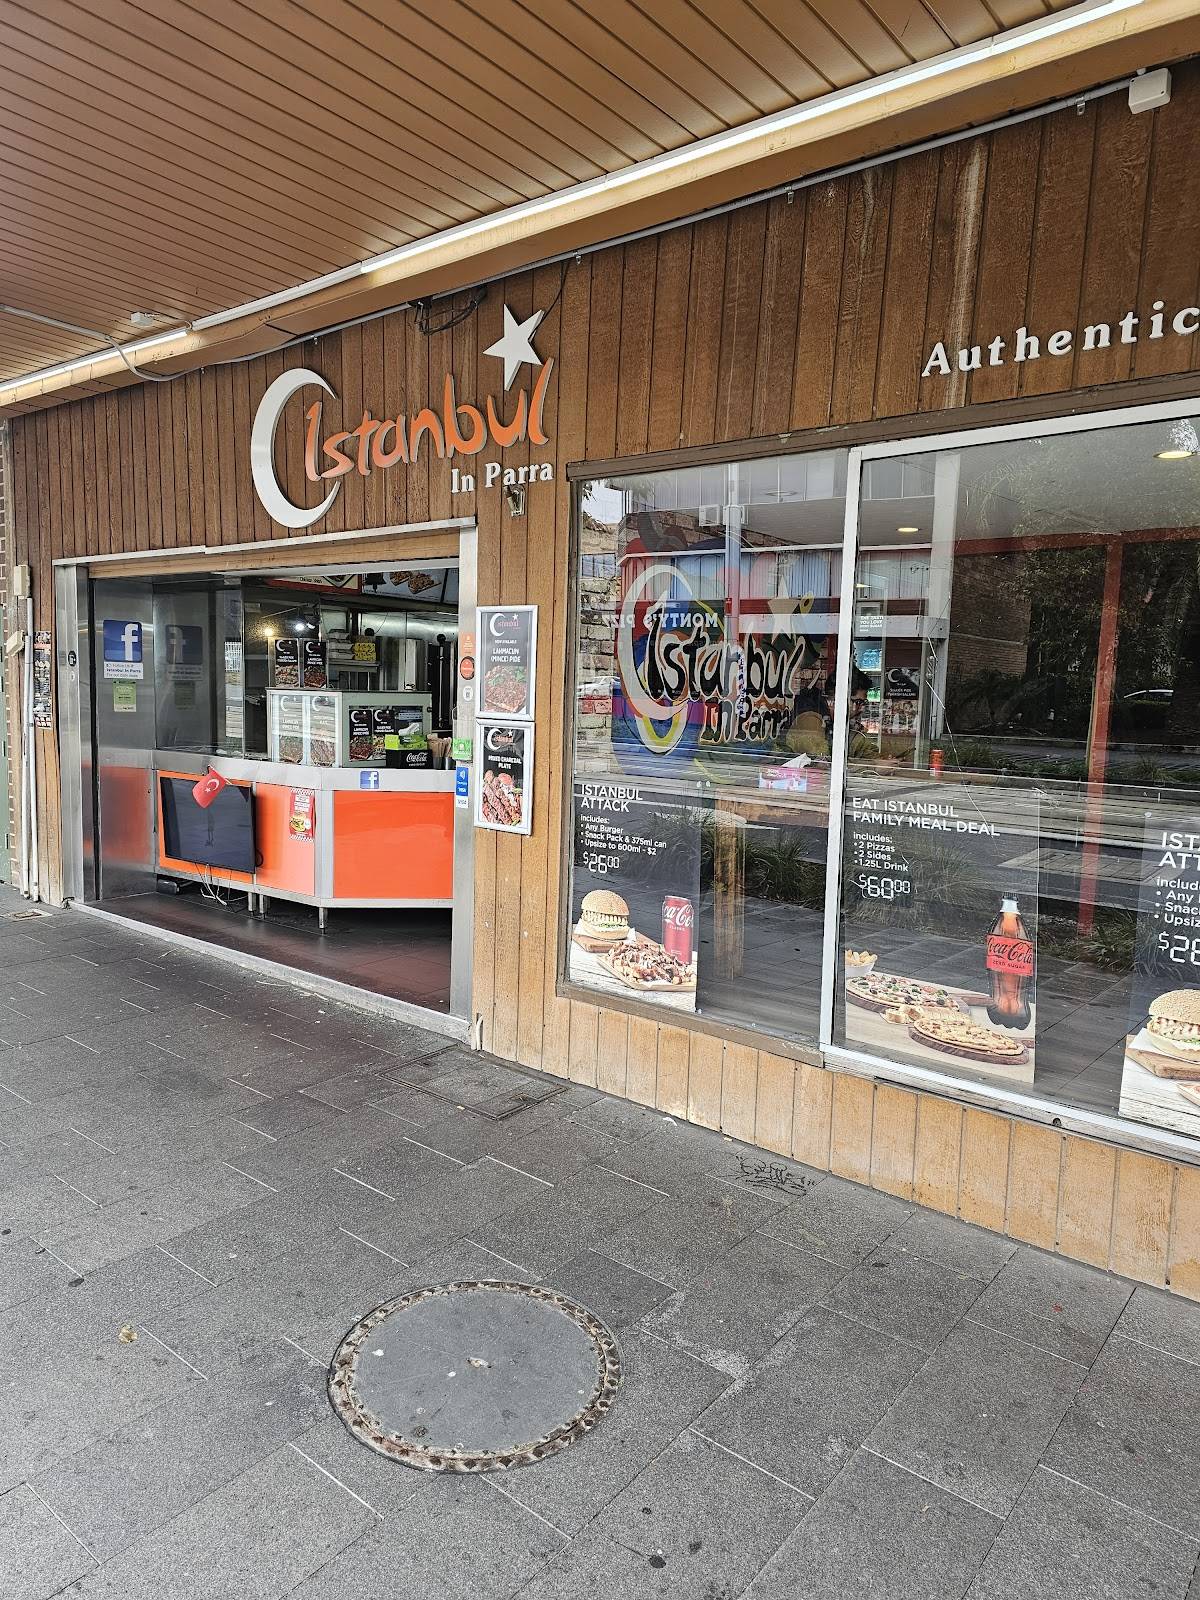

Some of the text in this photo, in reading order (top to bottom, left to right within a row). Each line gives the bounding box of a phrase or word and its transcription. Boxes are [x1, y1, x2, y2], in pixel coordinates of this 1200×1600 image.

[921, 300, 1200, 377] Authentic
[304, 356, 554, 482] Istanbul
[450, 461, 554, 494] In Parra
[645, 602, 807, 702] Istanbul
[581, 784, 643, 801] ISTANBUL
[581, 797, 629, 812] ATTACK
[852, 798, 959, 818] EAT ISTANBUL
[580, 814, 610, 824] includes:
[853, 811, 1000, 836] FAMILY MEAL DEAL
[585, 823, 624, 835] Any Burger
[585, 831, 605, 840] Snack
[606, 834, 624, 843] Pack
[631, 836, 653, 846] 375ml
[853, 831, 893, 843] includes:
[1161, 831, 1200, 852] IST
[585, 839, 607, 849] Upsize
[608, 841, 616, 849] to
[618, 843, 641, 853] 600ml
[647, 847, 657, 856] $2
[866, 842, 895, 852] Pizzas
[859, 850, 891, 861] 2 Sides
[884, 862, 909, 872] Drink
[1156, 876, 1200, 891] includ
[1166, 890, 1194, 904] Any
[1164, 902, 1200, 916] Snac
